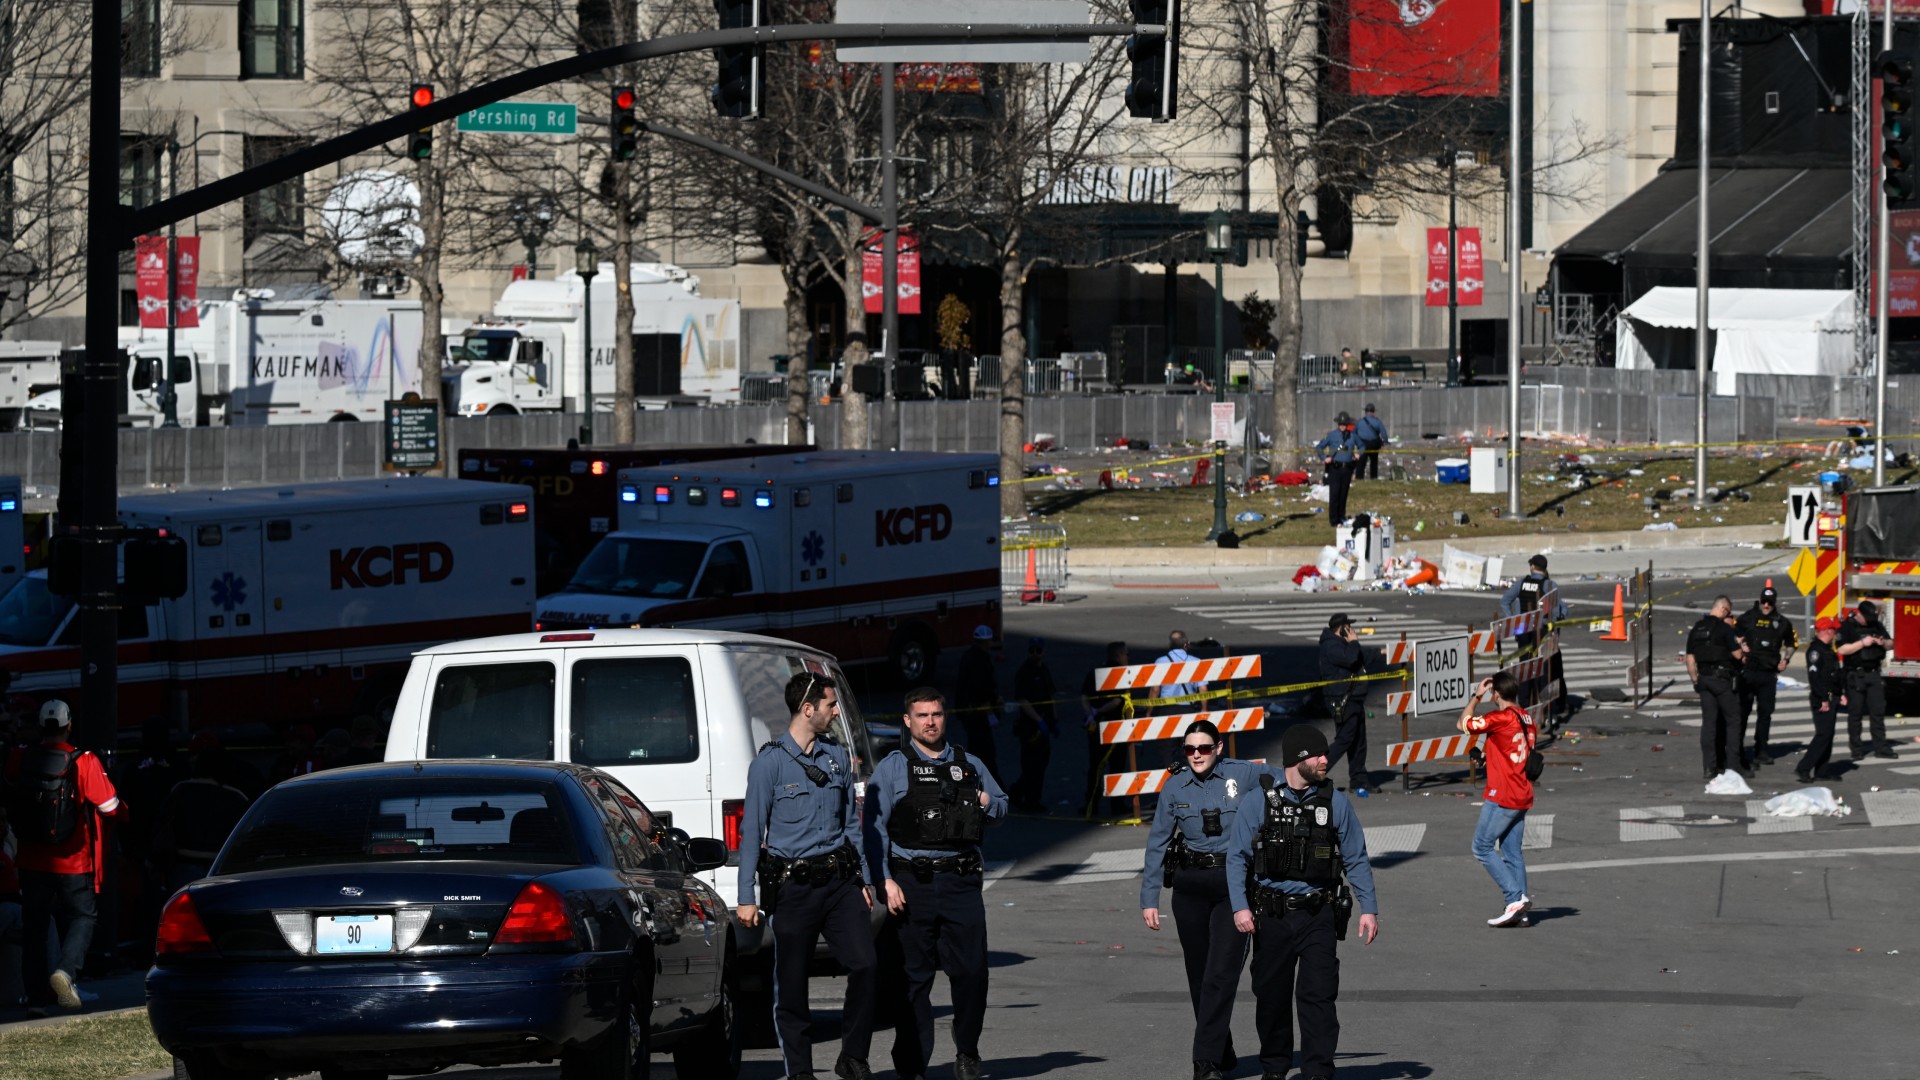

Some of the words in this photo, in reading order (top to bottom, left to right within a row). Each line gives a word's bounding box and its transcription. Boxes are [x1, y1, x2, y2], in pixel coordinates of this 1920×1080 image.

[468, 109, 537, 130] Pershing
[547, 110, 566, 127] Rd
[1128, 166, 1176, 204] CITY
[251, 356, 343, 378] KAUFMAN
[875, 503, 953, 548] KCFD
[329, 541, 455, 591] KCFD
[1522, 582, 1539, 592] POLICE
[540, 610, 611, 623] AMBULANCE
[1904, 605, 1920, 616] PU
[1426, 648, 1458, 673] ROAD
[1420, 677, 1465, 704] CLOSED
[913, 765, 936, 775] POLICE
[347, 924, 362, 944] 90
